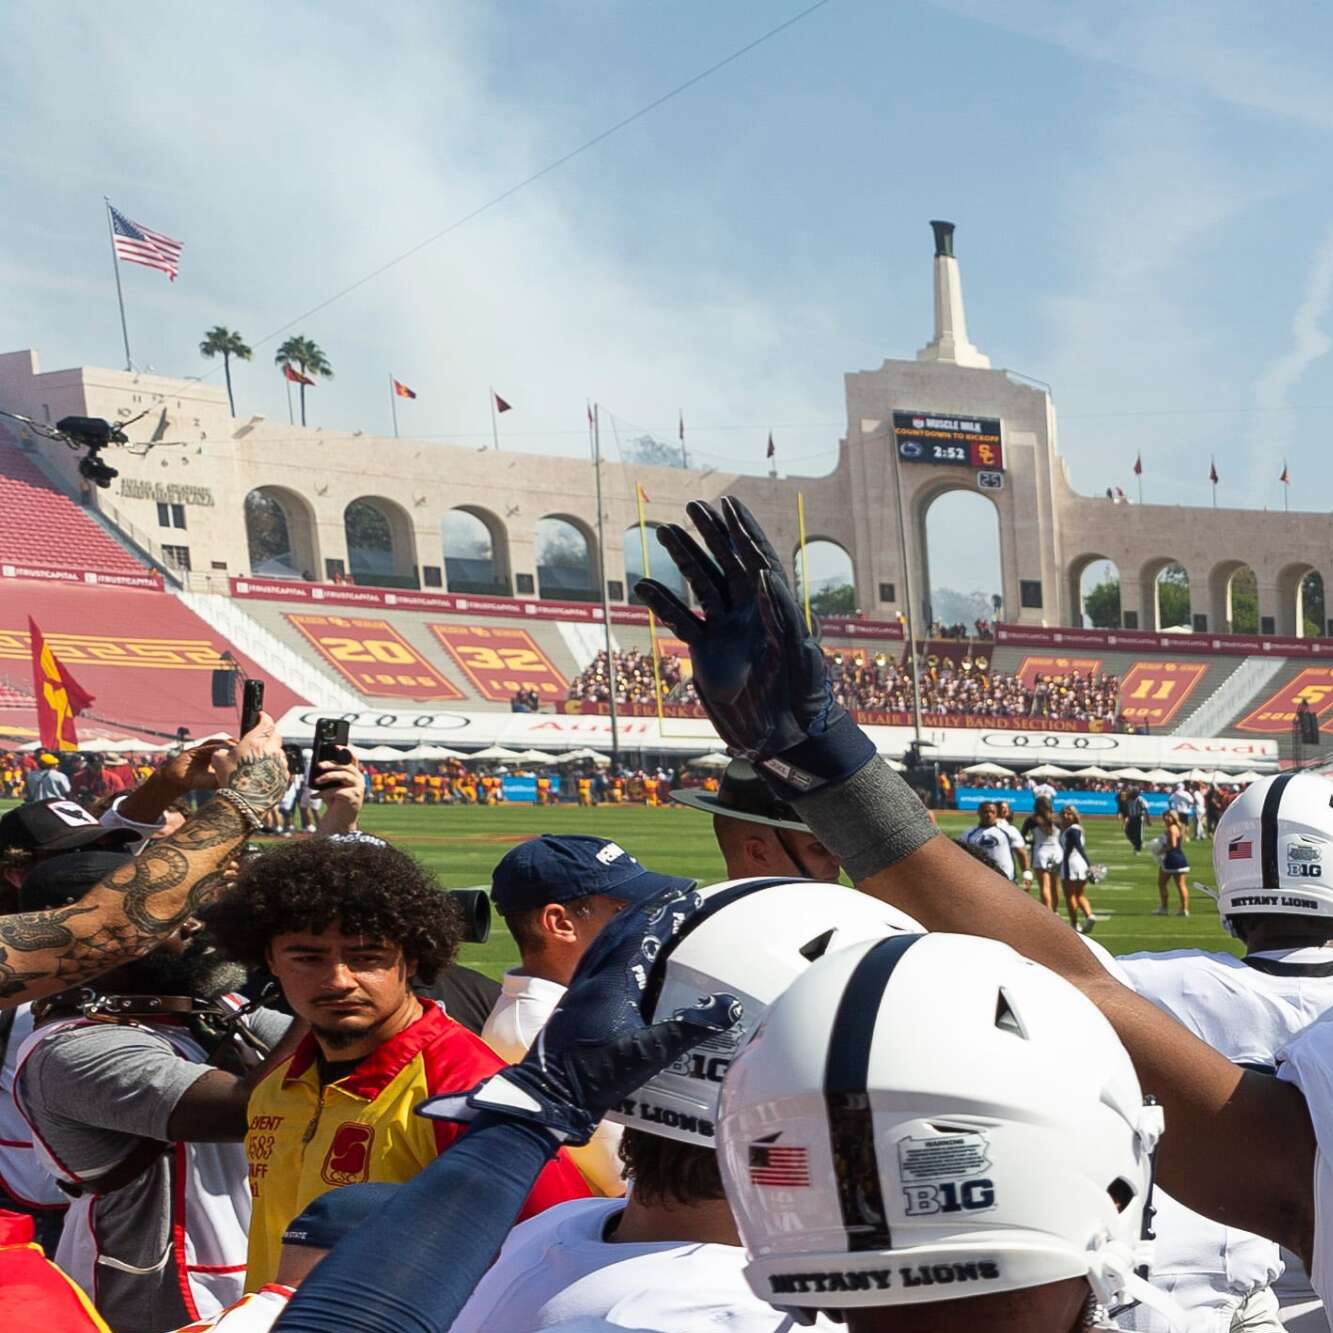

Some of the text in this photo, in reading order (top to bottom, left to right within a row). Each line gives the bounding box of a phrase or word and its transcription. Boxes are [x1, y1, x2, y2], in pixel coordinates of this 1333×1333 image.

[933, 446, 965, 459] 2:52
[318, 637, 417, 664] 20
[456, 646, 548, 672] 32
[1130, 680, 1177, 699] 11
[1291, 685, 1333, 704] 5
[857, 710, 1077, 732] BLAIR FMILY BAND SECTION
[1257, 712, 1297, 720] 200
[530, 720, 648, 733] Audi
[1172, 742, 1268, 755] Audi
[1287, 863, 1322, 877] B1G
[1231, 896, 1319, 909] NITTANY LIONS
[631, 963, 647, 990] PSU
[639, 1102, 716, 1138] LIONS
[925, 1138, 965, 1148] WARNING
[330, 1171, 357, 1184] CSC
[903, 1178, 996, 1217] B1G
[768, 1260, 1001, 1294] NITTANY LIONS
